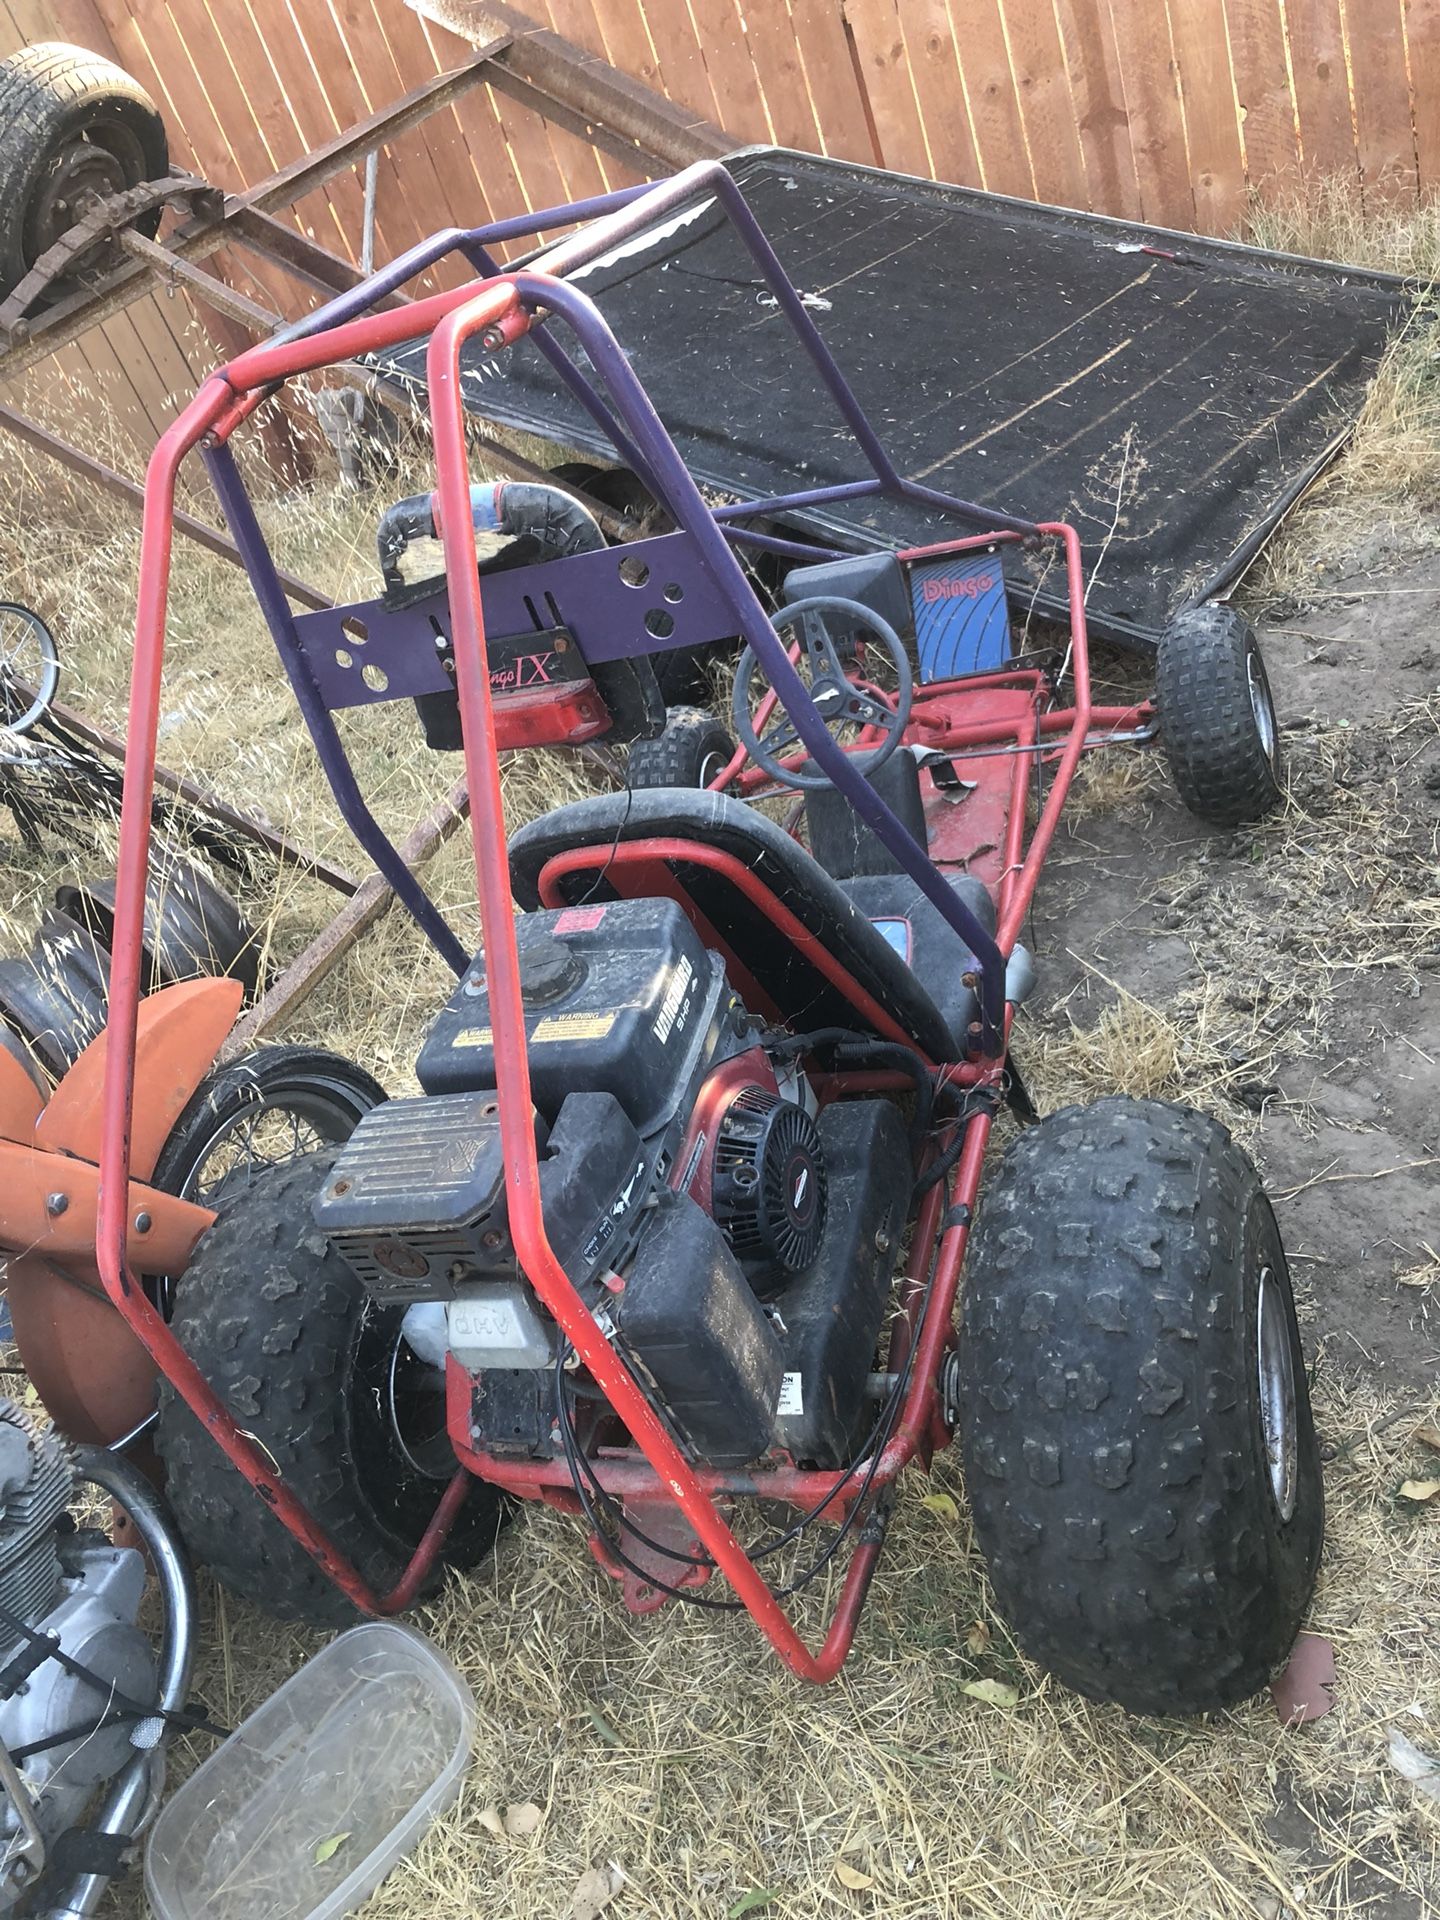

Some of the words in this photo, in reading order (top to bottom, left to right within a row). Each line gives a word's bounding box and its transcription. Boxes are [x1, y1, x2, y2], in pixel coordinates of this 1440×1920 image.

[923, 574, 993, 603] Dingo
[512, 651, 556, 688] IX
[558, 1012, 600, 1021] WARNING
[652, 953, 693, 1045] VANGUARD
[583, 1235, 598, 1255] CHOKE
[599, 1220, 609, 1233] RUN
